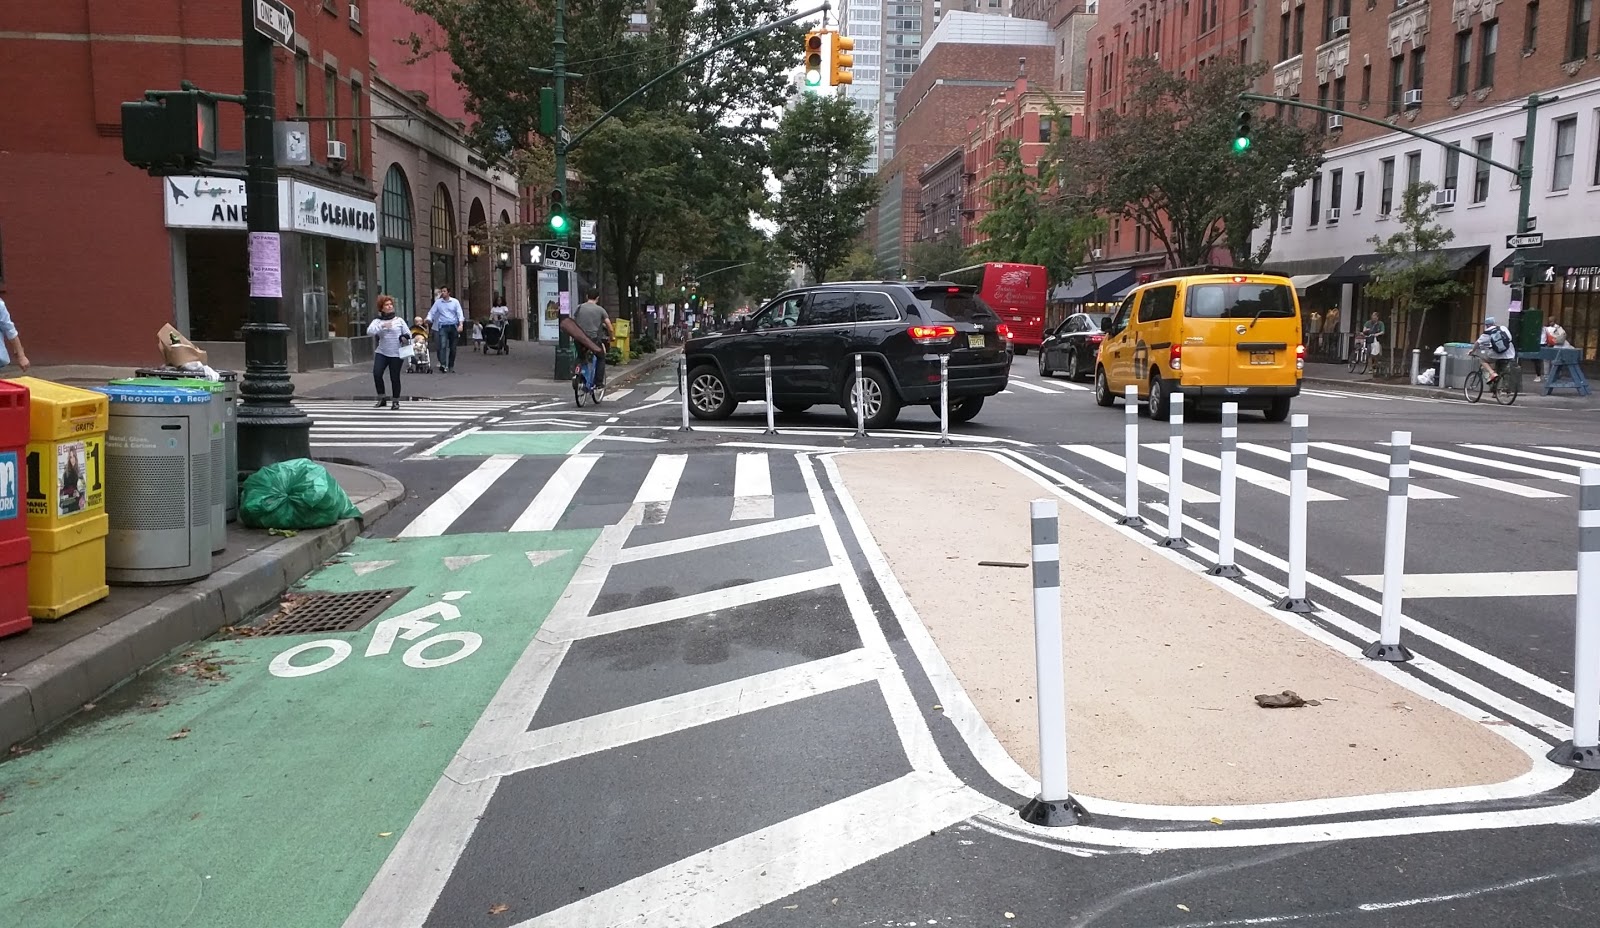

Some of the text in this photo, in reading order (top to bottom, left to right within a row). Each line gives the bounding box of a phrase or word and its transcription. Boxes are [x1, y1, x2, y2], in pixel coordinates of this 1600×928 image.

[261, 2, 290, 36] ONE WAY
[321, 201, 375, 232] CLEANERS
[560, 261, 573, 269] PATH
[120, 394, 164, 403] Recycle
[75, 422, 94, 432] GRATIS
[0, 496, 15, 511] ORK
[27, 507, 48, 515] KLY!
